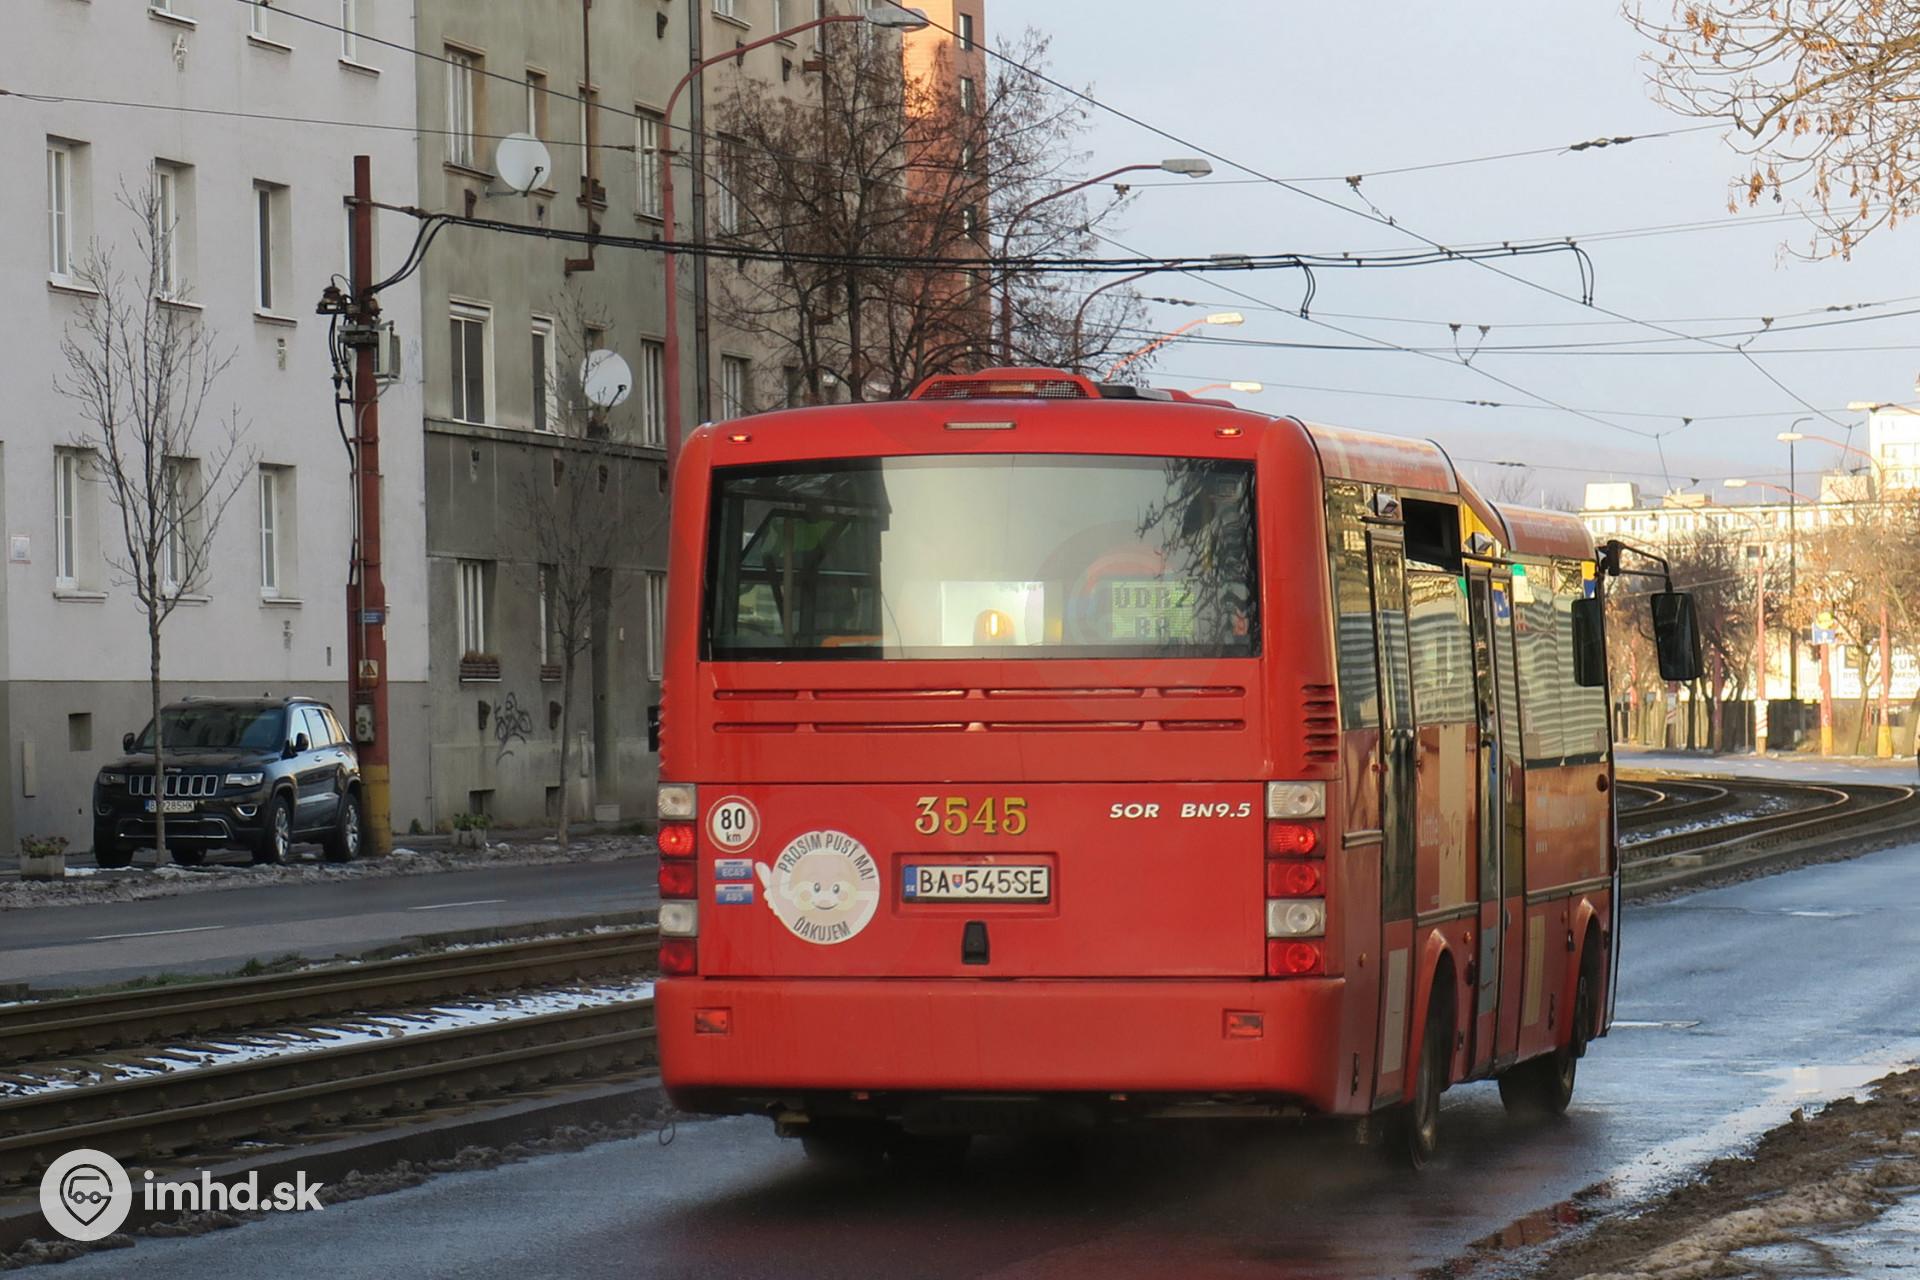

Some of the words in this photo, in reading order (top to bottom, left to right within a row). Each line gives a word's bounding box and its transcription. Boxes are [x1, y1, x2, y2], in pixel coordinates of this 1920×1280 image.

[720, 808, 746, 830] 80
[914, 796, 1027, 834] 3545
[1109, 803, 1159, 818] SOR
[1180, 802, 1251, 818] BN9.5
[725, 832, 742, 843] km
[919, 869, 950, 895] BA
[964, 869, 1044, 895] 545SE
